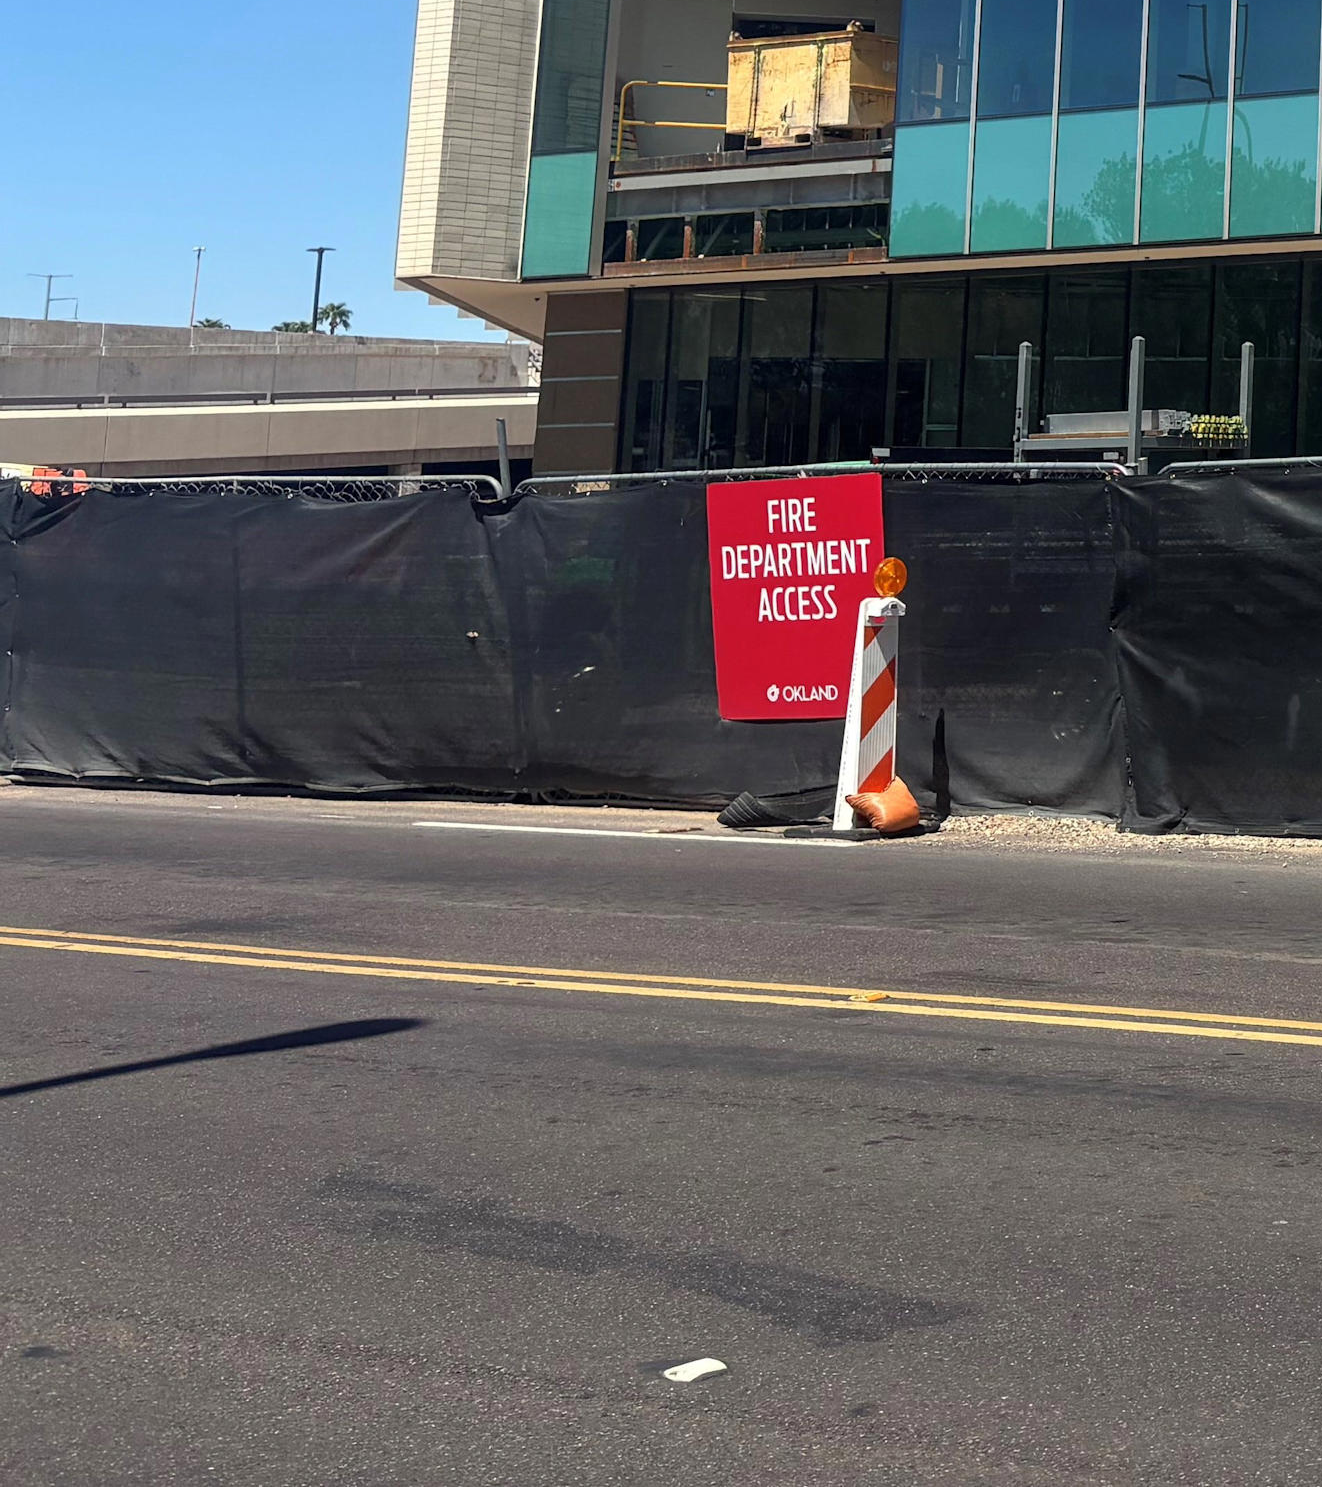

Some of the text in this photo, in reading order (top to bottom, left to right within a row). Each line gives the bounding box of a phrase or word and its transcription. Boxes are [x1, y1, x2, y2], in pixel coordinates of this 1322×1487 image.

[768, 497, 817, 533] FIRE
[721, 538, 871, 580] DEPARTMENT
[758, 584, 837, 622] ACCESS
[782, 684, 838, 702] OKLAND
